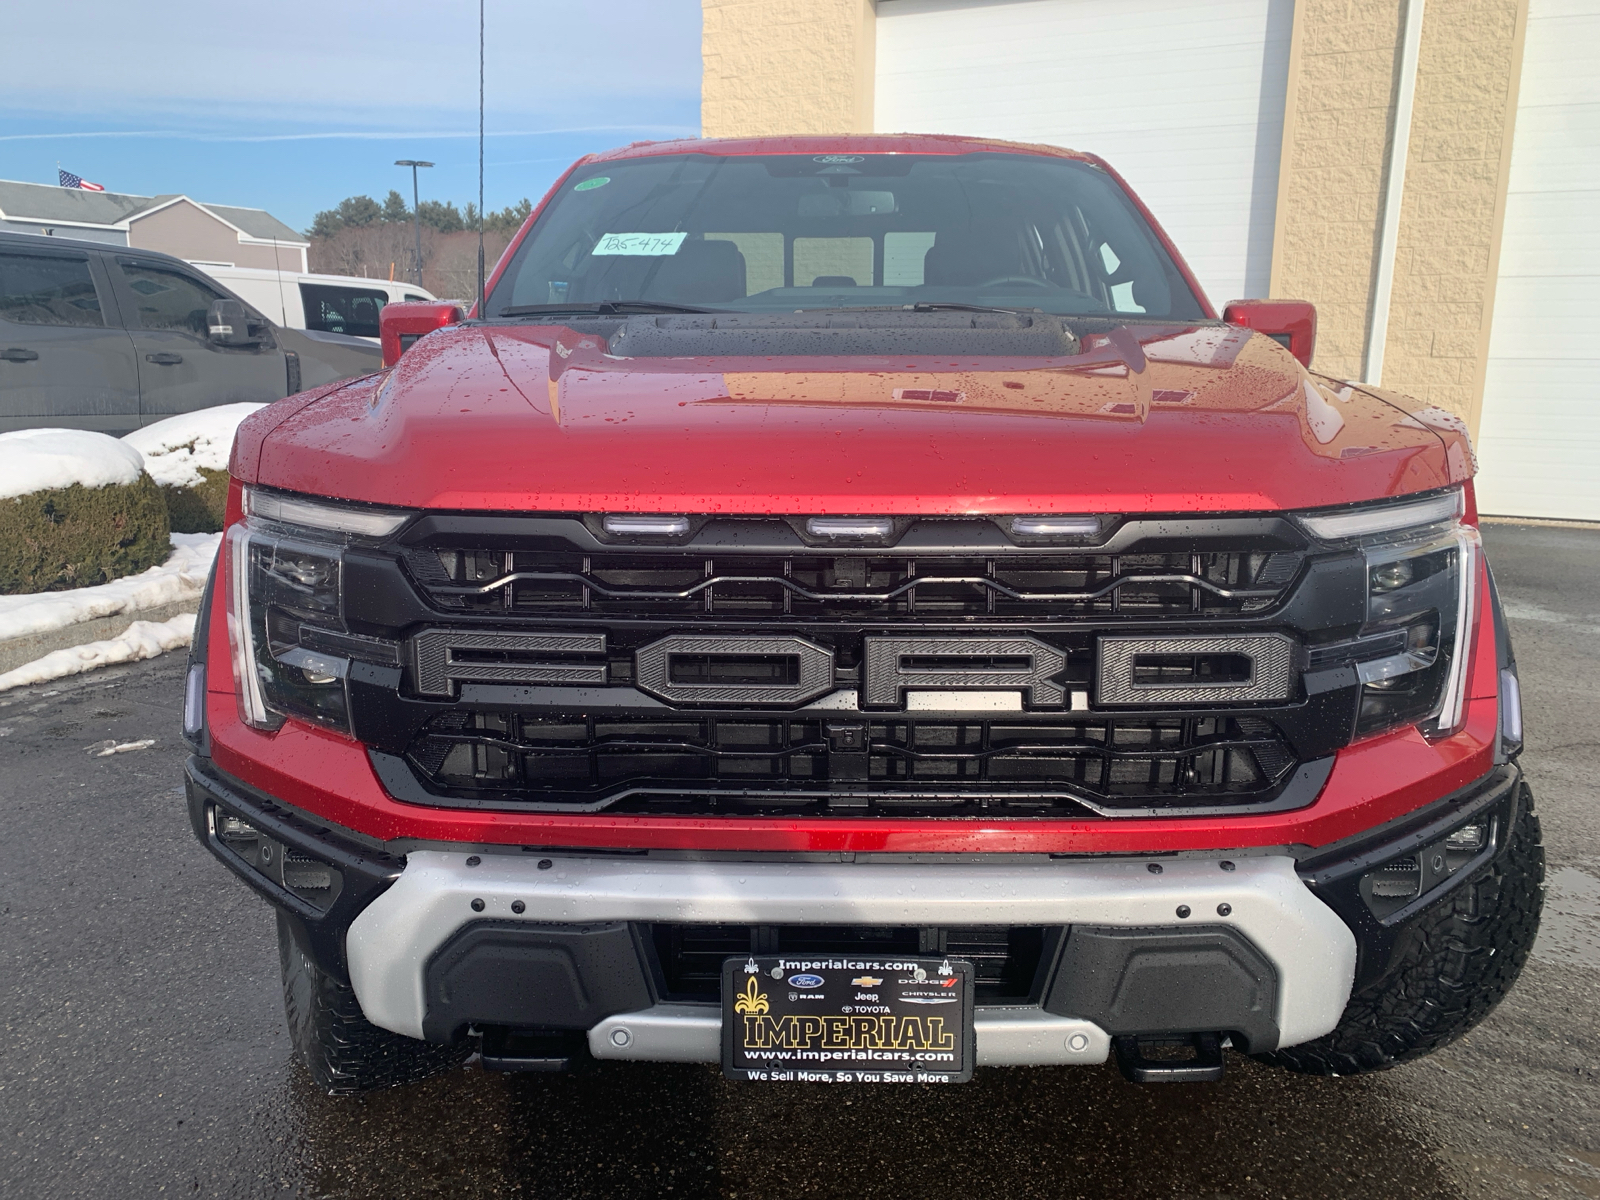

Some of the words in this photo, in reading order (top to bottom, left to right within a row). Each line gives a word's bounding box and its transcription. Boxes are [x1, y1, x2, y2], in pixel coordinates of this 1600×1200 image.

[413, 629, 1295, 706] FORD
[778, 959, 918, 971] Imperialcars.com
[796, 977, 816, 986] Ford
[854, 992, 879, 1002] Jeep
[855, 1006, 891, 1014] TOYOTA
[744, 1016, 954, 1050] IMPERIAL
[744, 1049, 954, 1061] www.imperialcars.com
[747, 1071, 768, 1081] We
[771, 1071, 794, 1081] Sell
[798, 1072, 832, 1083] More,
[836, 1072, 852, 1082] So
[856, 1072, 878, 1082] You
[883, 1073, 914, 1083] Save
[918, 1073, 949, 1083] More
